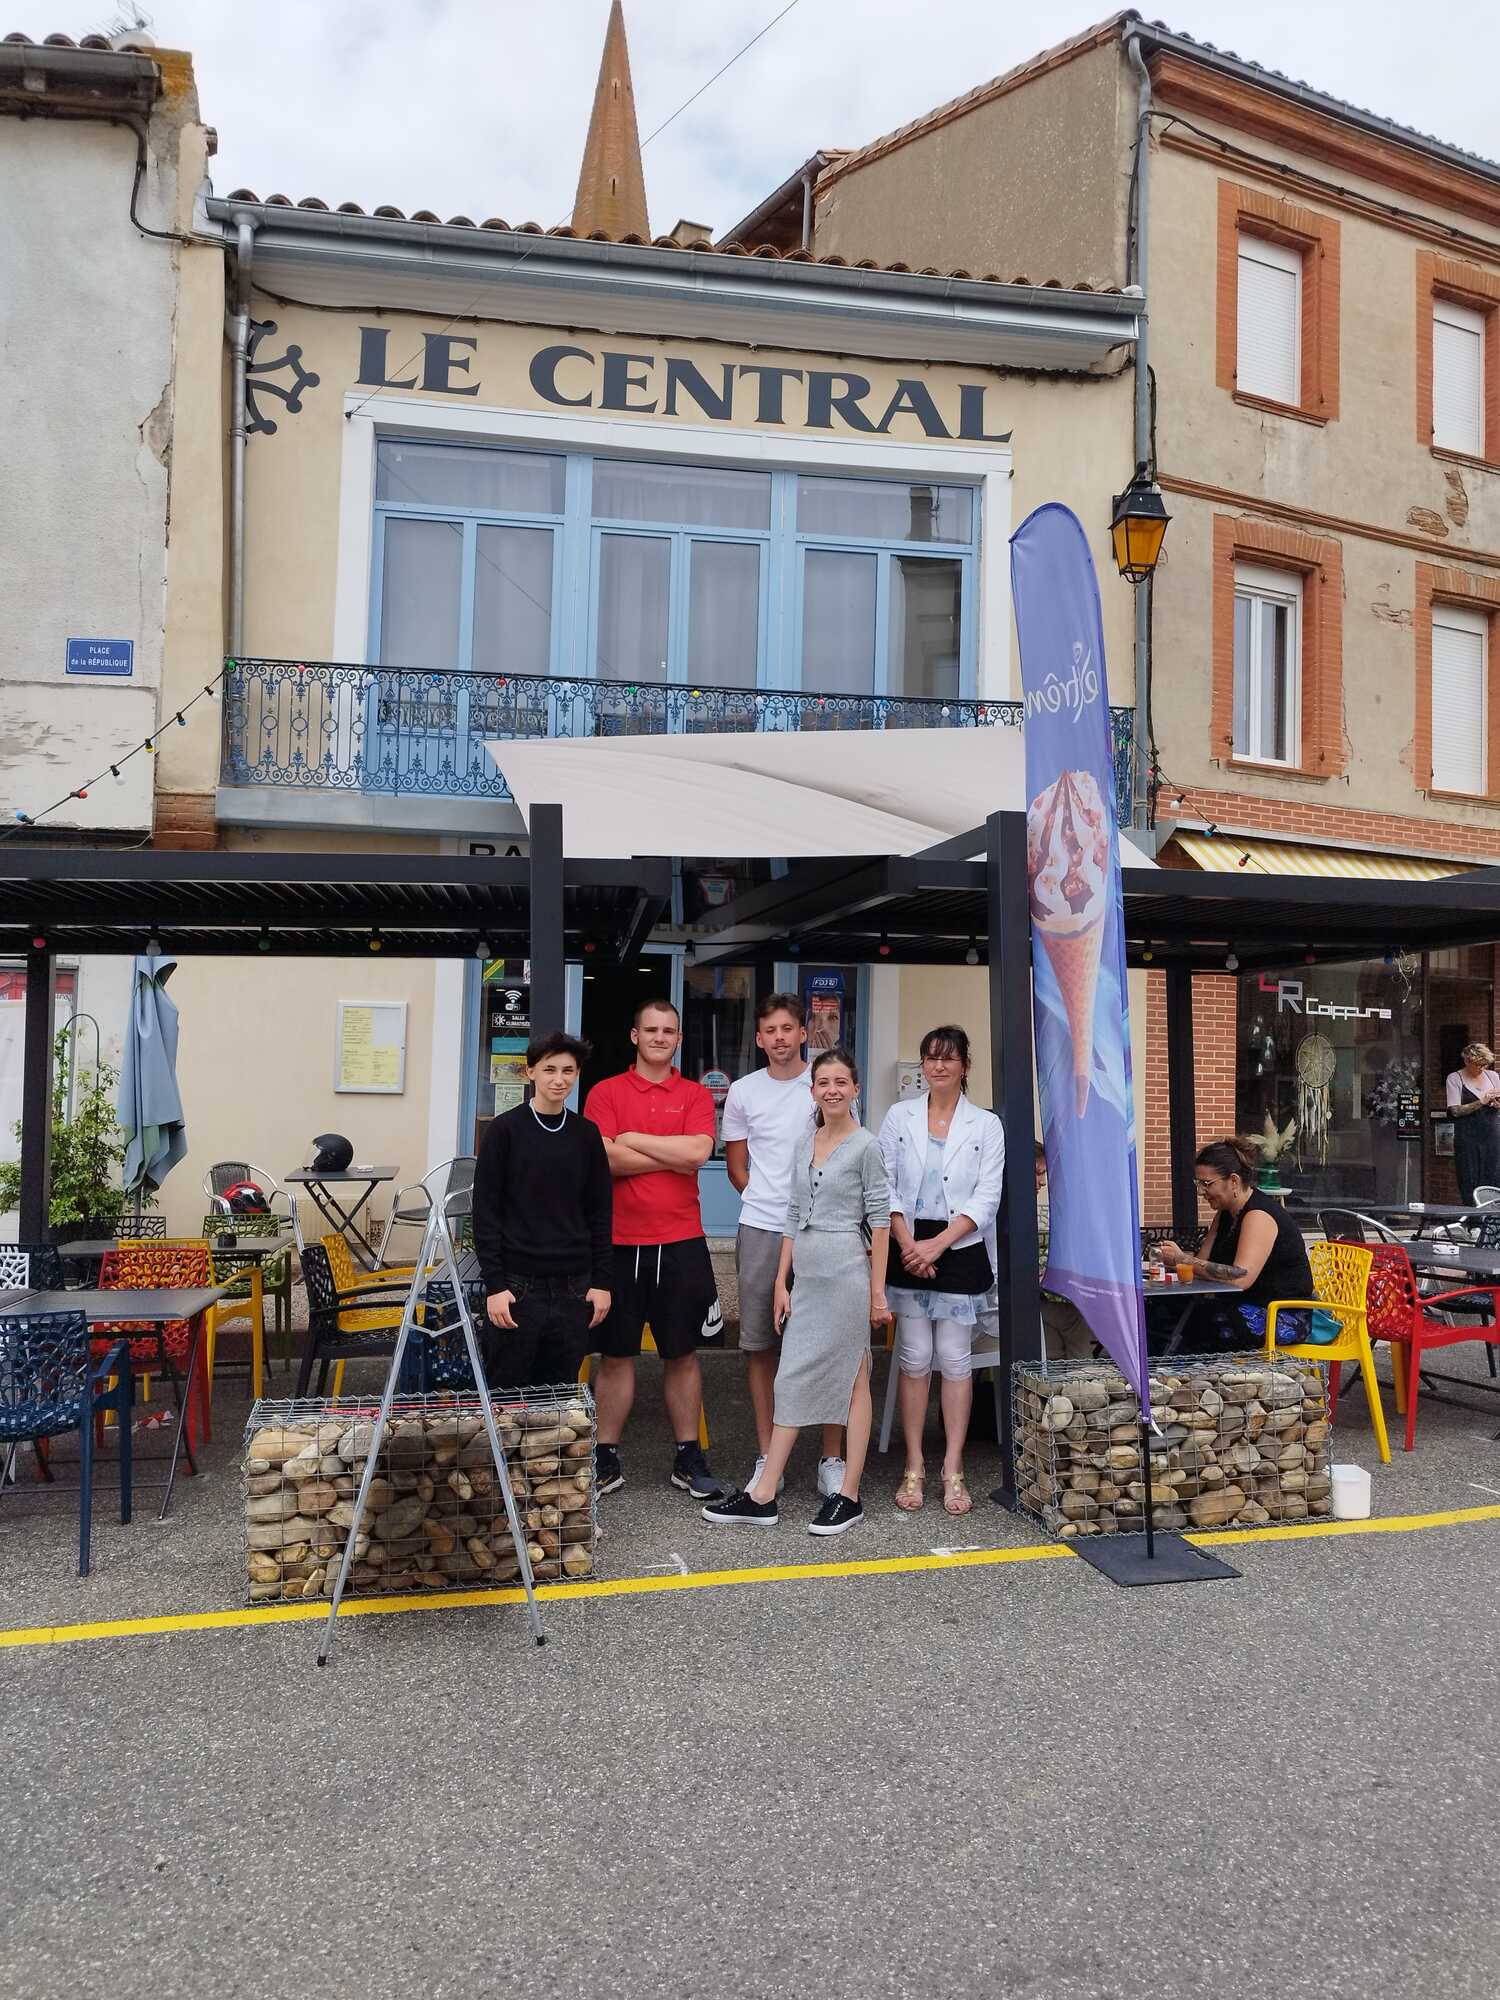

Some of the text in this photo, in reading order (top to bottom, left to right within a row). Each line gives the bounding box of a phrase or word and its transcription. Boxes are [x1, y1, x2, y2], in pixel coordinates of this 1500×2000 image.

[354, 326, 1014, 443] LE CENTRAL
[89, 646, 110, 655] PLACE
[80, 658, 87, 666] la
[88, 657, 129, 667] RÉPUBLIQUE
